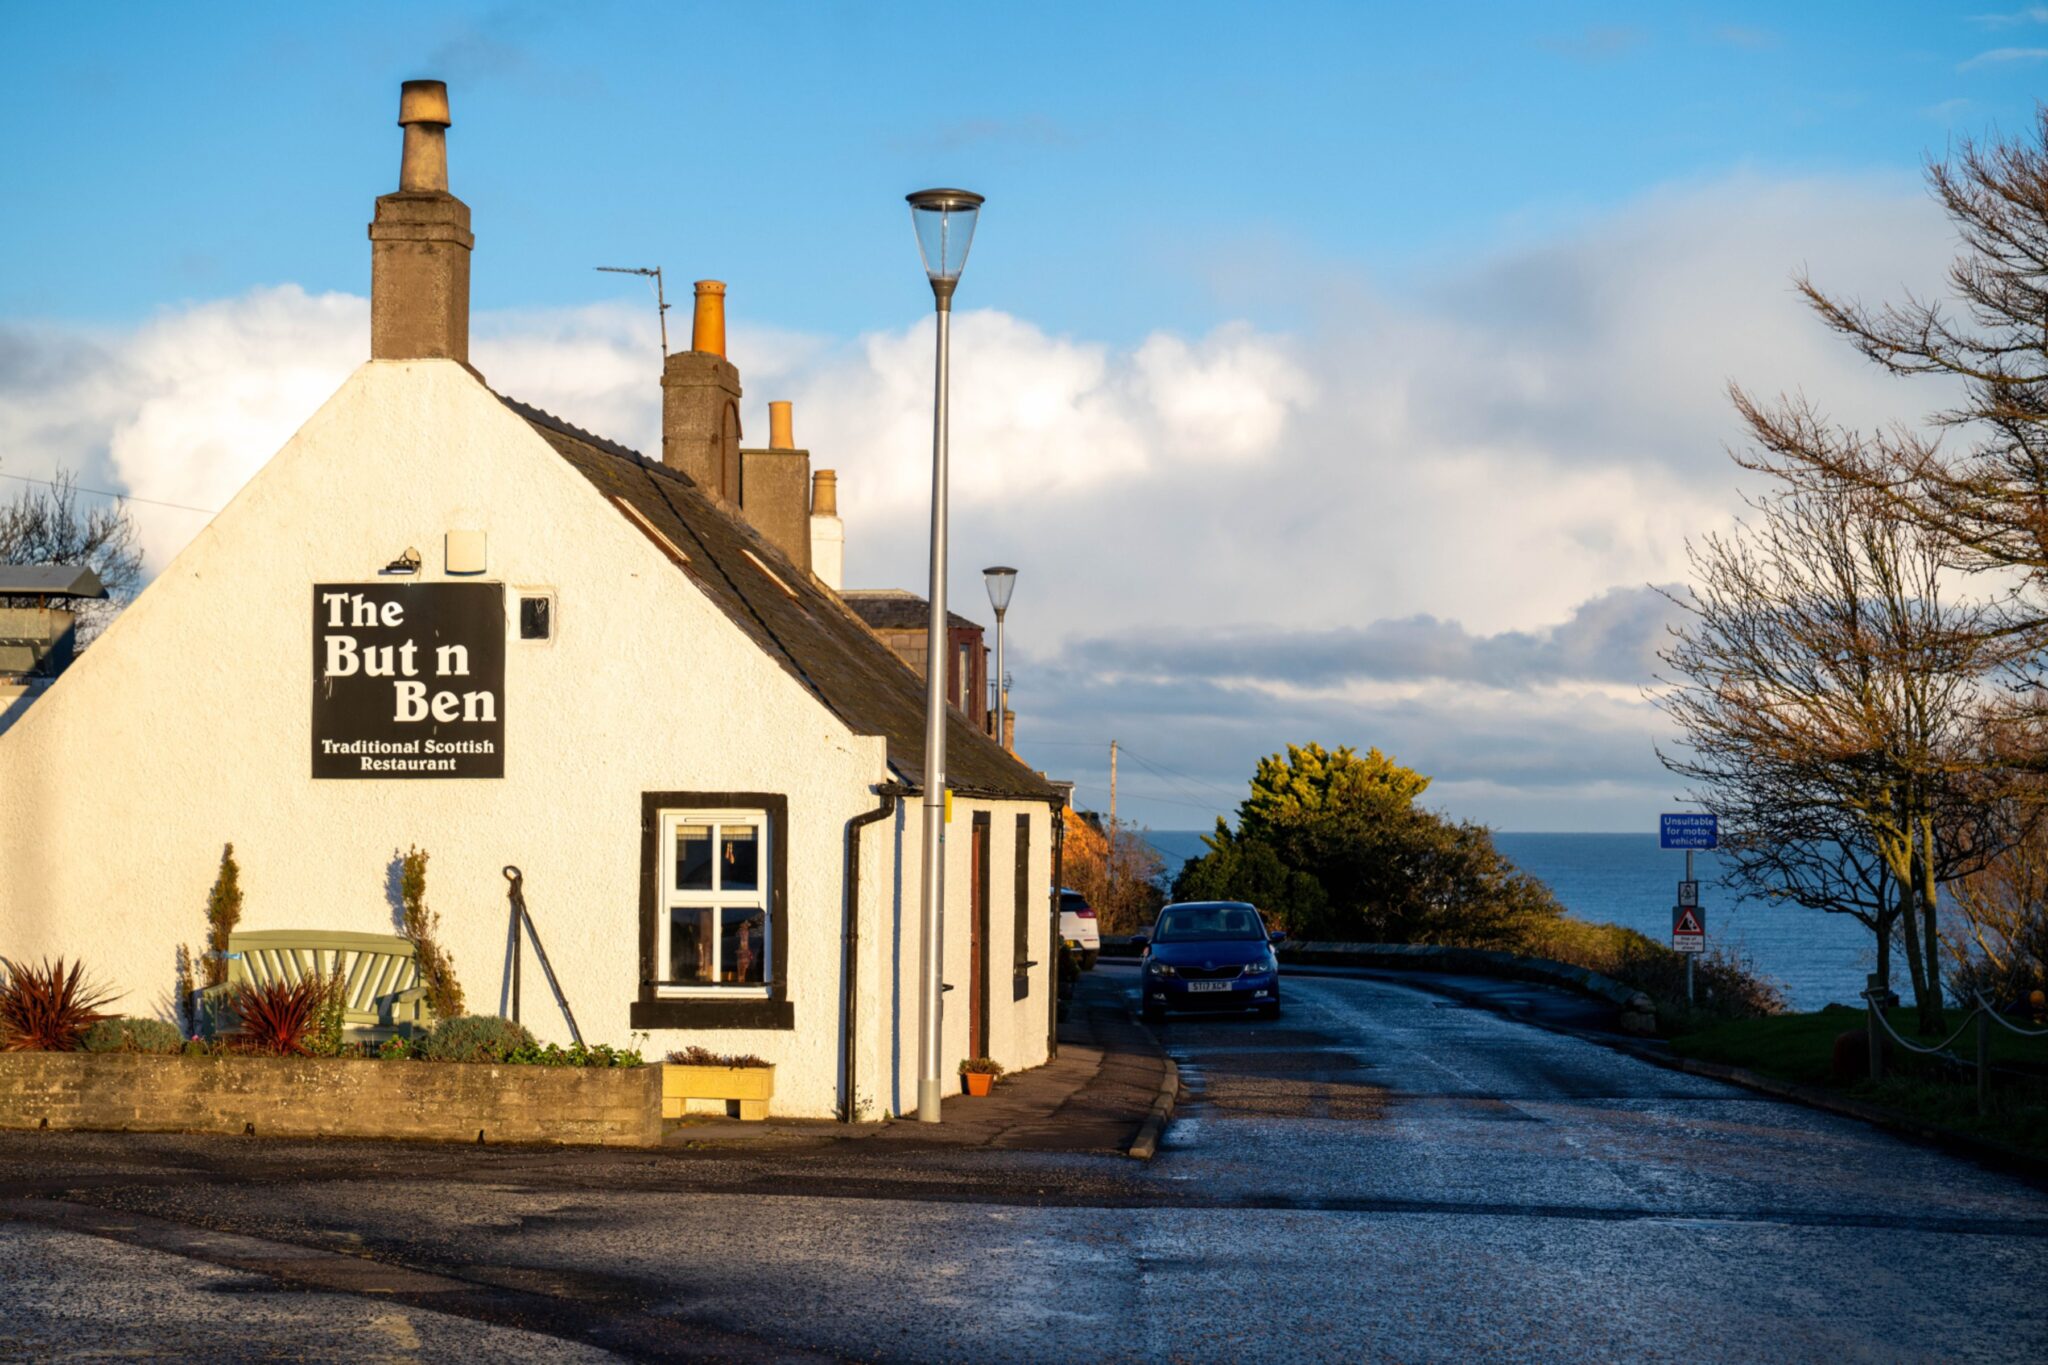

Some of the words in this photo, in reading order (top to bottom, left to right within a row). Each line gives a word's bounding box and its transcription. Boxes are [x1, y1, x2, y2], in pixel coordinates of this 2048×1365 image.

[323, 593, 404, 627] The
[324, 635, 419, 677] But
[436, 644, 470, 675] n
[394, 681, 496, 722] Ben
[322, 739, 419, 754] Traditional
[424, 739, 494, 754] Scottish
[361, 756, 456, 771] Restaurant
[1664, 817, 1714, 826] Unsuitable
[1666, 827, 1680, 835] for
[1670, 837, 1708, 845] vehicles
